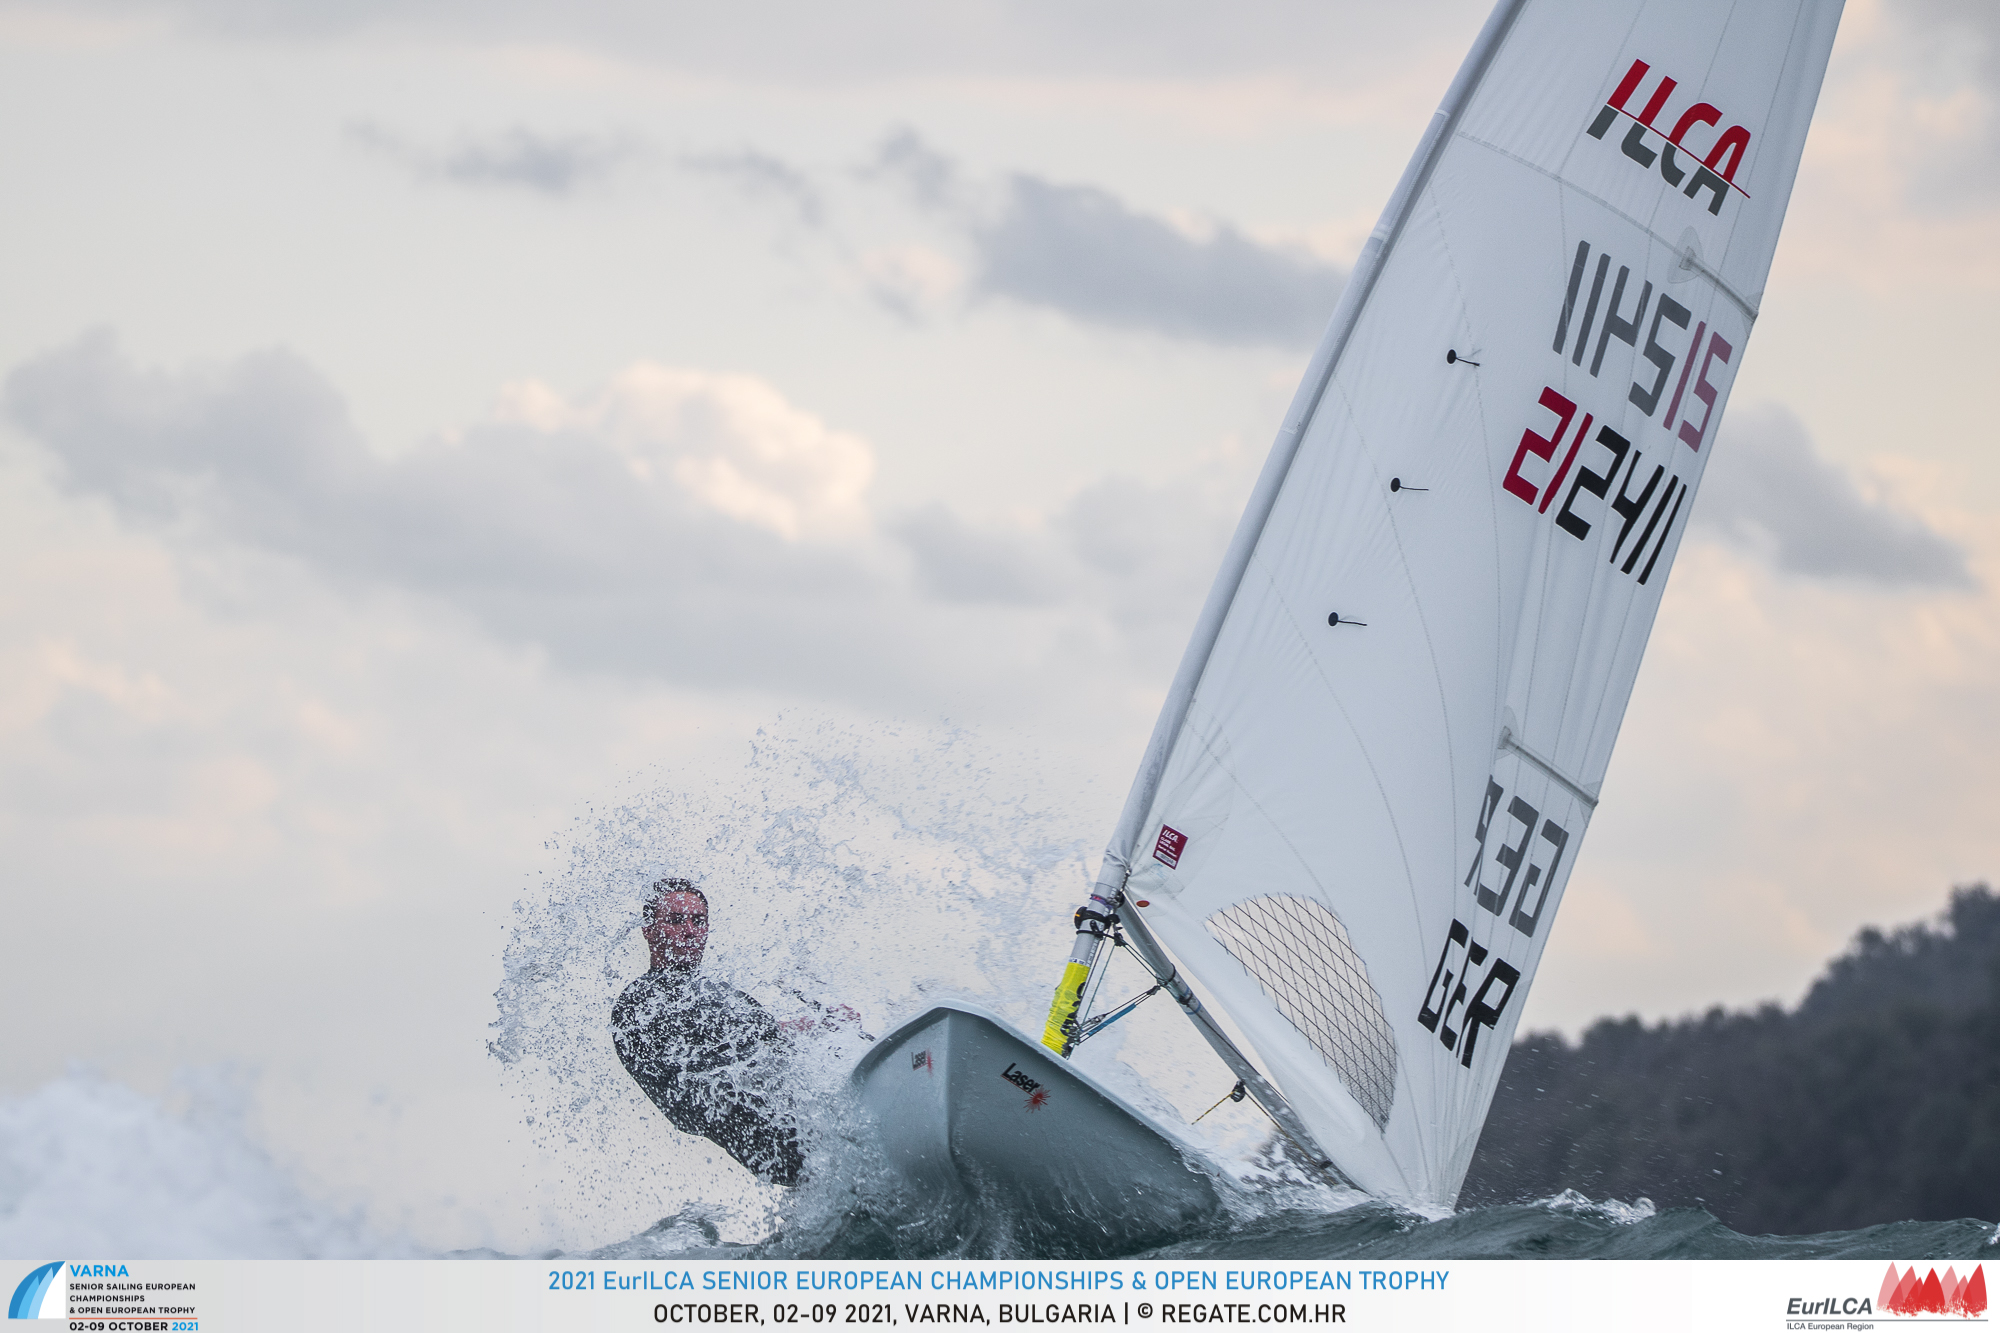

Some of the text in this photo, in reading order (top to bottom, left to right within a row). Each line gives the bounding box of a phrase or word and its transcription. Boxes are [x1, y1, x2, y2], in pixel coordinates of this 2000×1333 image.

[1586, 58, 1751, 216] ILCA
[1503, 386, 1687, 585] 212411
[1417, 918, 1521, 1069] GER
[1001, 1062, 1041, 1092] Laser
